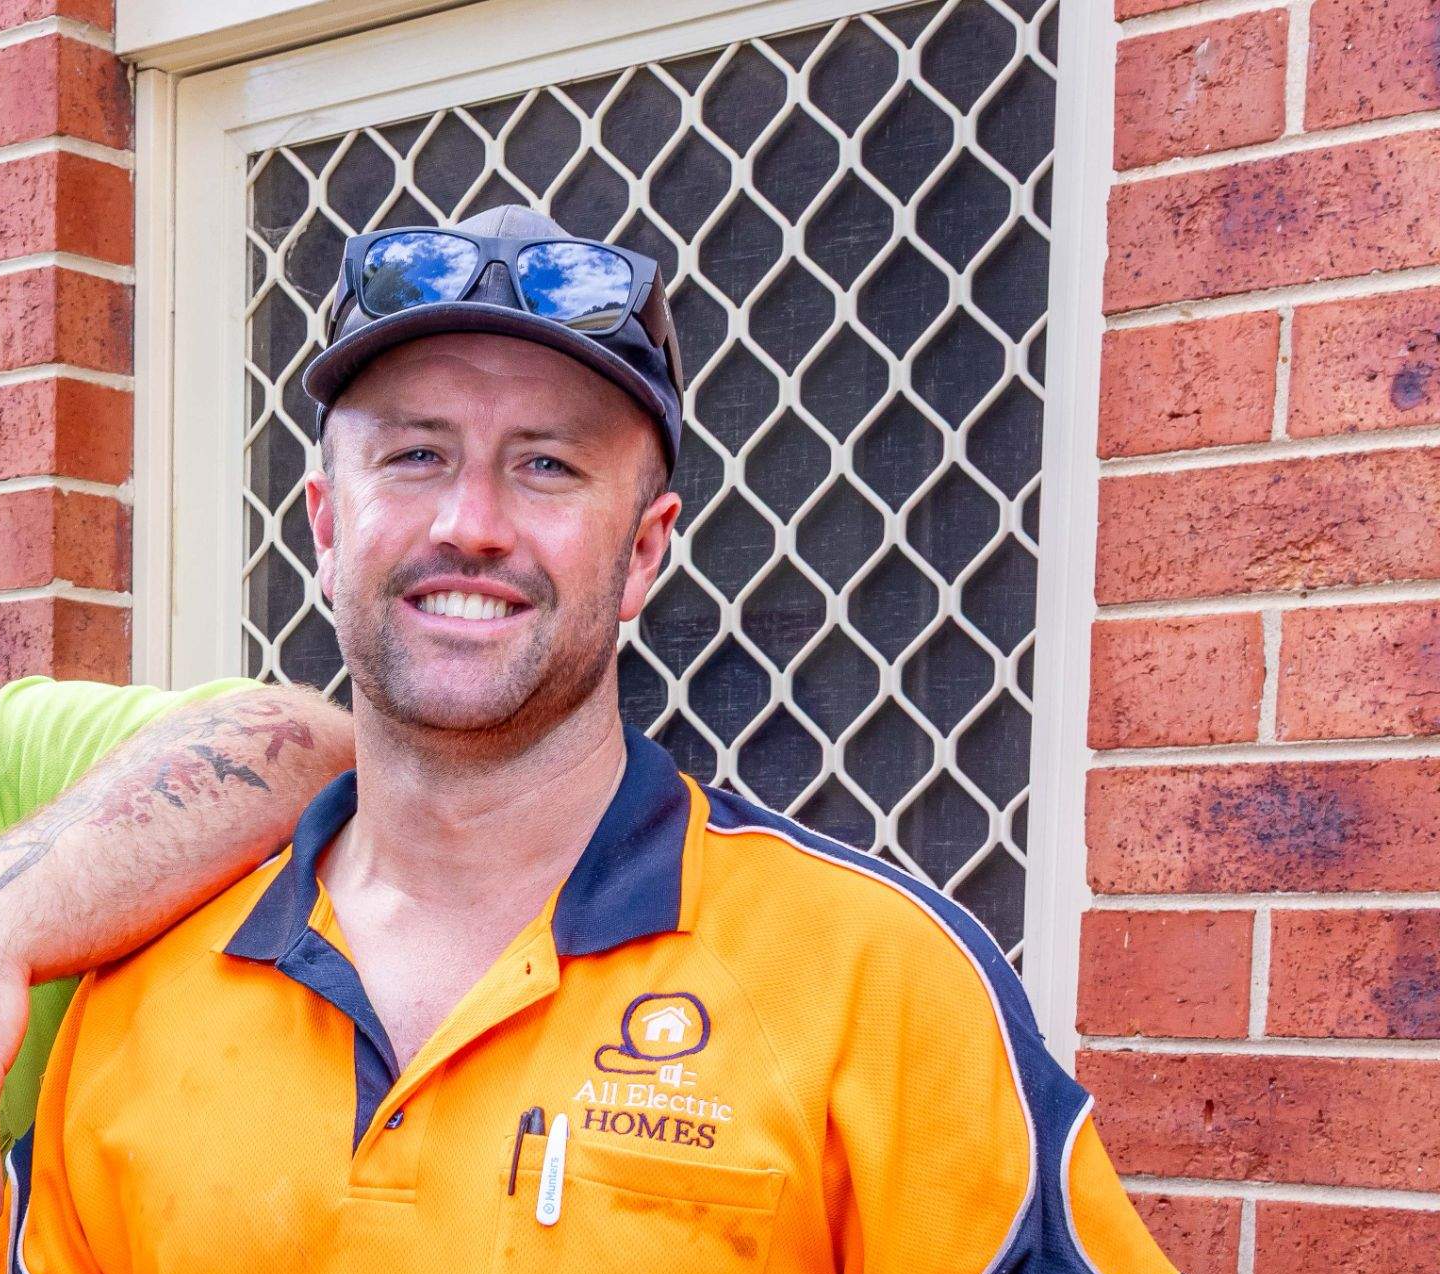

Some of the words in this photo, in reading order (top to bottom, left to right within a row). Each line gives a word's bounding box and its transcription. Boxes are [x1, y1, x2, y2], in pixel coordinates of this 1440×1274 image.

[572, 1079, 618, 1106] All
[624, 1083, 734, 1121] Electric
[582, 1108, 717, 1150] HOMES
[545, 1157, 559, 1201] Munters
